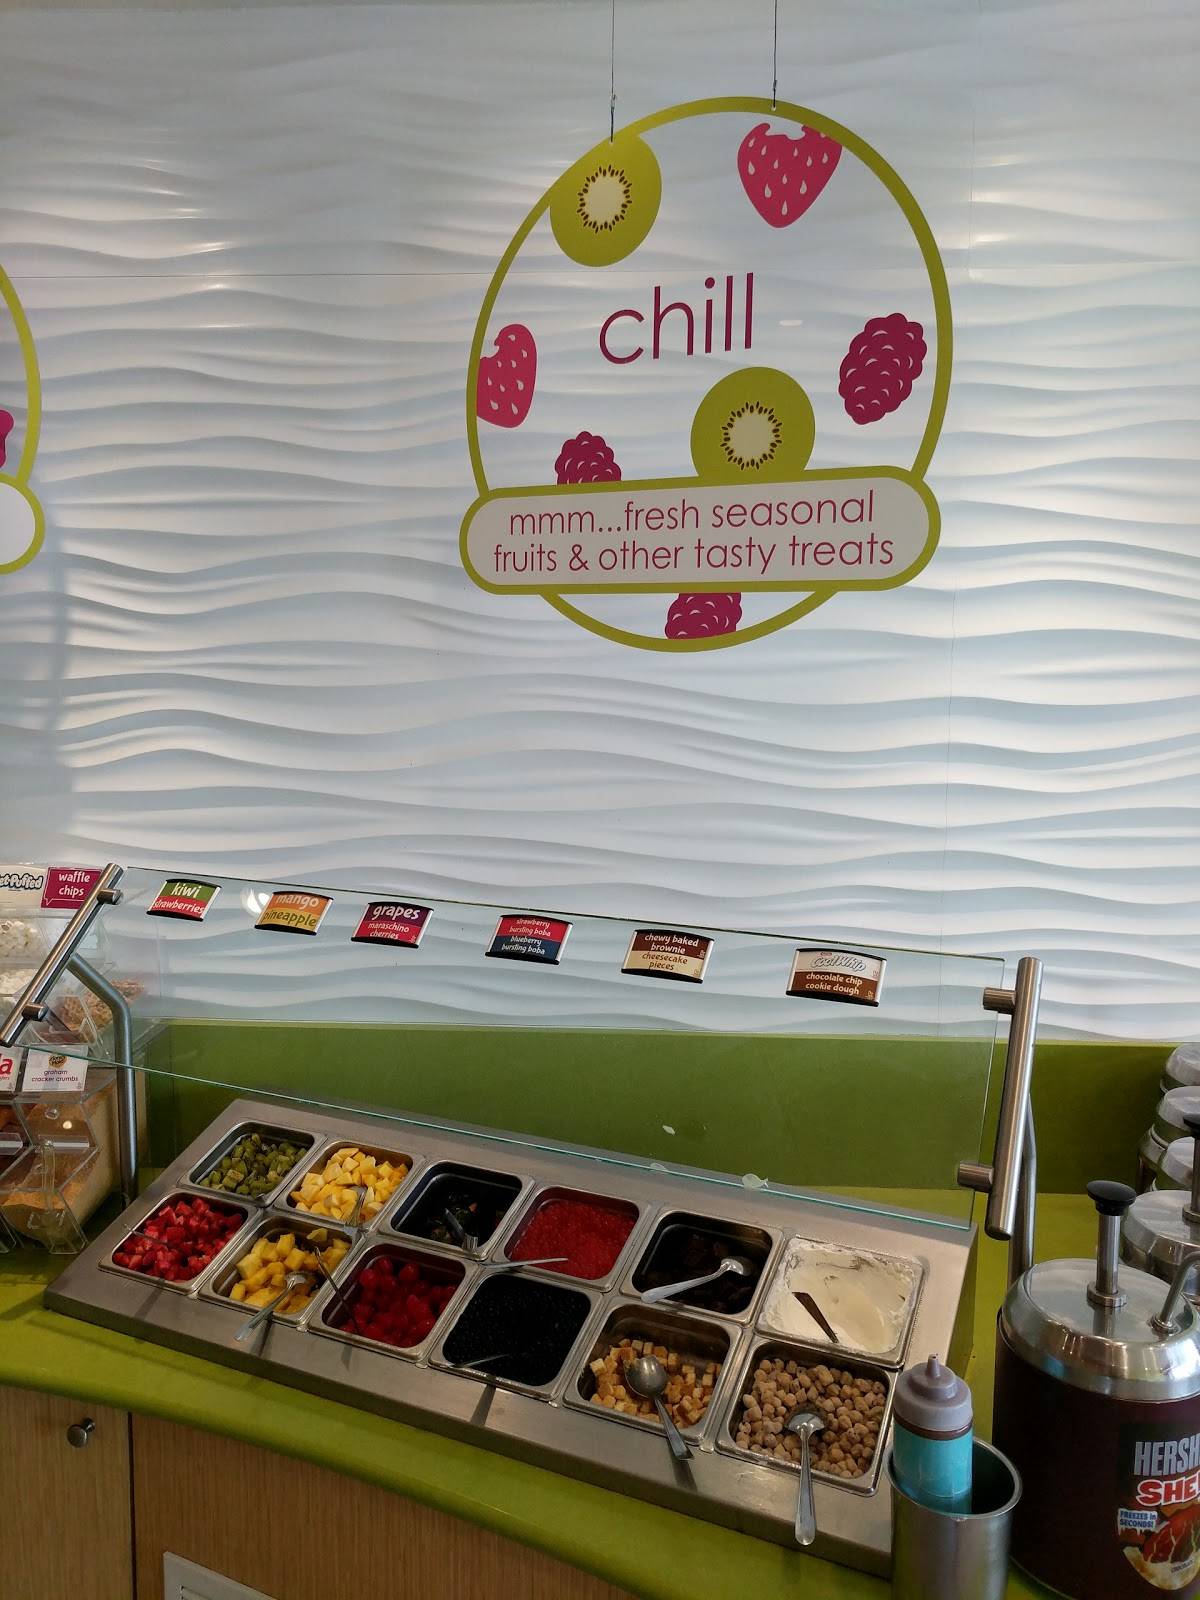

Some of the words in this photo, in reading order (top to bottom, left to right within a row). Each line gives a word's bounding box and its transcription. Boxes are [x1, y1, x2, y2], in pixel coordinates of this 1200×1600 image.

[599, 272, 754, 364] chill
[711, 489, 874, 528] seasonal
[494, 543, 557, 572] fruits
[568, 543, 589, 571] &
[598, 540, 684, 570] other
[694, 536, 776, 575] tasty
[788, 532, 894, 566] treats
[58, 871, 90, 883] waffle
[58, 884, 85, 898] chips
[170, 882, 202, 898] kiwi
[275, 894, 320, 910] mango
[260, 910, 317, 927] pineapple
[371, 905, 421, 920] grapes
[367, 922, 409, 933] maraschino
[516, 918, 550, 930] strawberry
[369, 929, 399, 940] cherries
[533, 928, 551, 937] boba
[644, 932, 671, 945] chewy
[672, 934, 699, 947] baked
[510, 936, 542, 947] blueberry
[650, 941, 686, 955] brownie
[527, 945, 546, 955] boba
[641, 952, 688, 965] cheesecake
[649, 961, 675, 971] pieces
[806, 972, 844, 983] chocolate
[845, 975, 863, 987] chip
[805, 982, 832, 990] cookie
[833, 983, 860, 996] dough
[1134, 1433, 1200, 1476] HERSH
[1136, 1469, 1200, 1506] SHE
